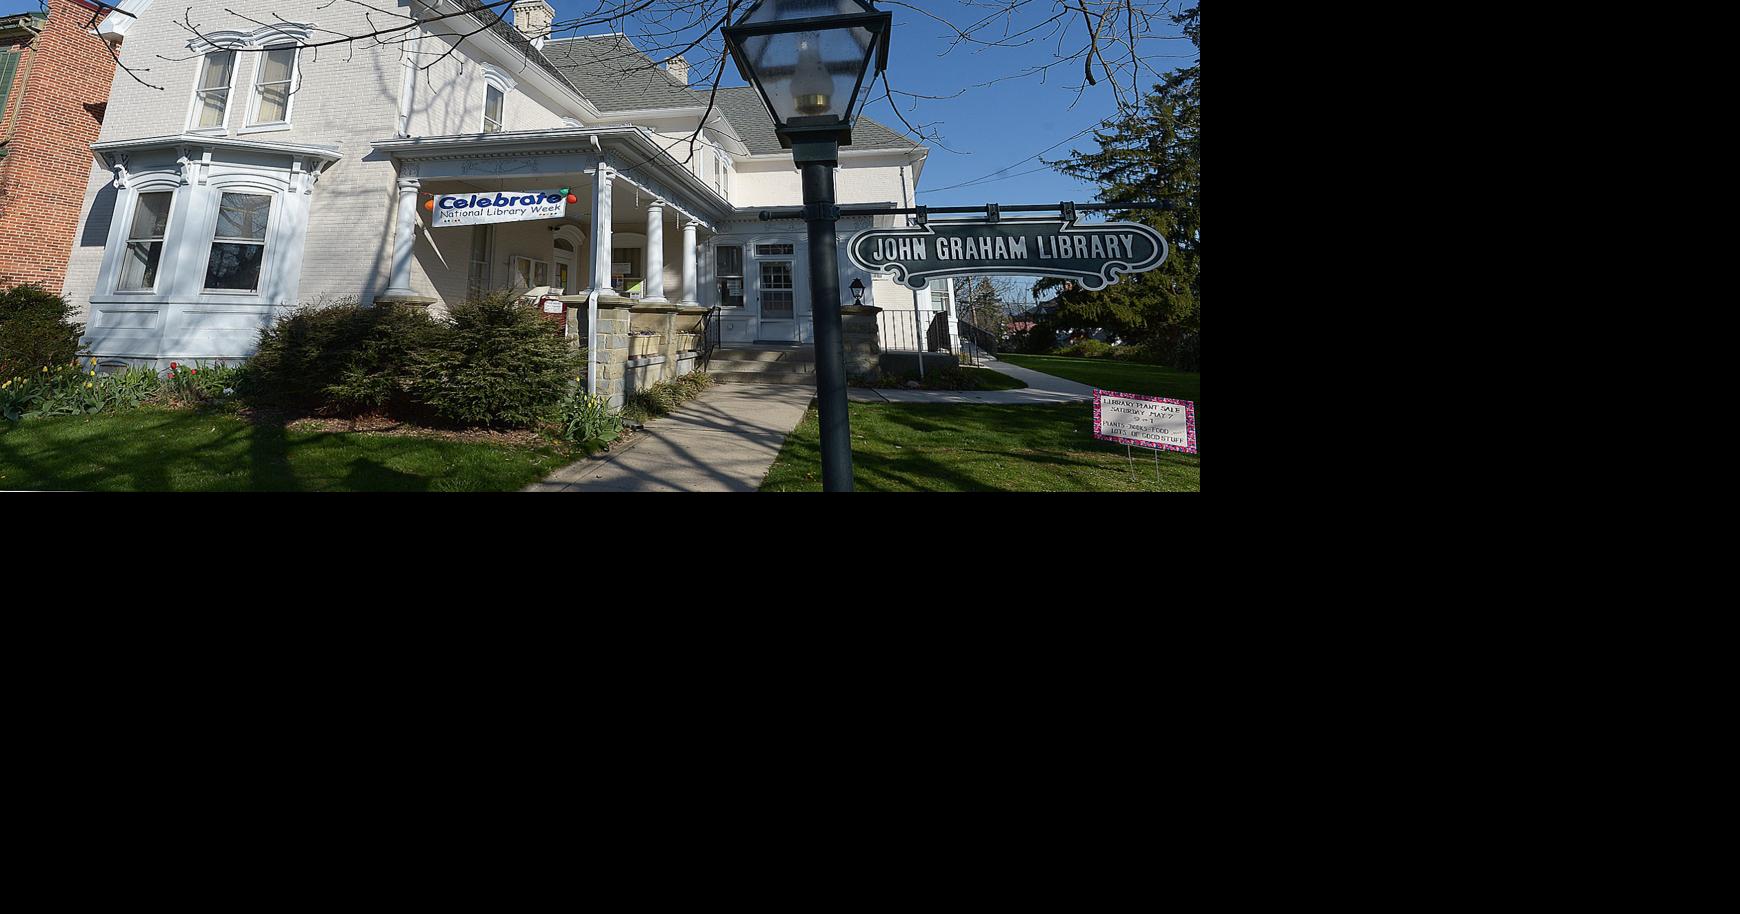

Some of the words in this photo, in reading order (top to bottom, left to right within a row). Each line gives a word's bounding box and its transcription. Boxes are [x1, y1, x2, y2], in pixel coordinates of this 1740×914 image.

[438, 192, 562, 210] Celebrate
[440, 208, 484, 219] National
[486, 207, 527, 217] Library
[530, 204, 561, 214] Week
[873, 237, 927, 261] JOHN
[936, 235, 1028, 260] GRAHAM
[1037, 234, 1134, 259] LIBRARY
[1103, 398, 1134, 407] LIBRARY
[1136, 402, 1158, 411] PLANT
[1160, 405, 1181, 413] SALE
[1110, 406, 1145, 416] SATURDAY
[1149, 411, 1166, 419] MAY
[1111, 428, 1127, 436] LOTS
